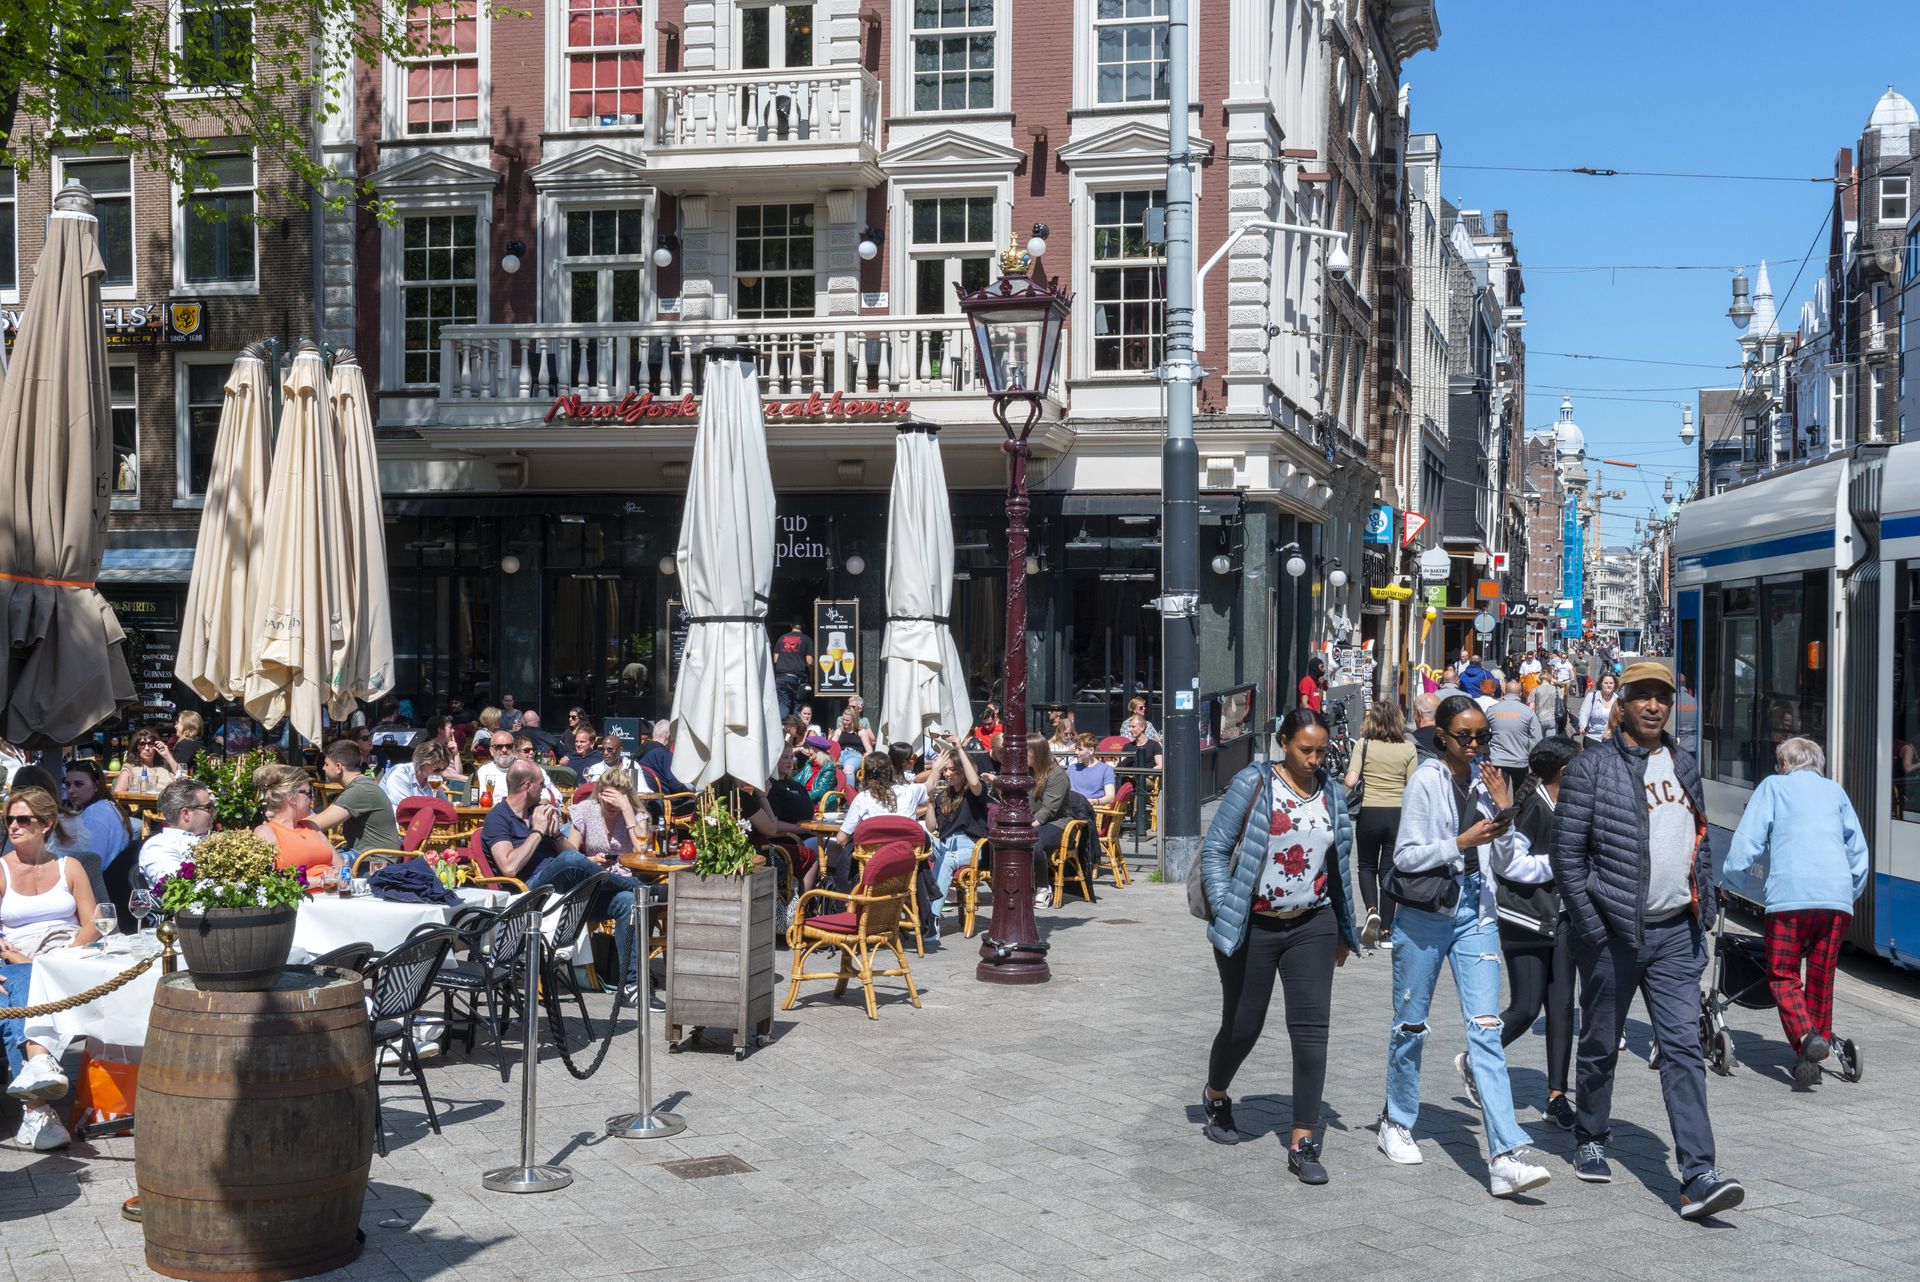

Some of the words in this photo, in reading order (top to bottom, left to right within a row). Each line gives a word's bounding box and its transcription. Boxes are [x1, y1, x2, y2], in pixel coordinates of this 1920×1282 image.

[617, 392, 699, 425] York
[762, 391, 911, 416] eakhouse
[1368, 512, 1380, 522] to
[776, 515, 808, 531] ub
[1371, 520, 1385, 532] go
[122, 602, 156, 612] SPIRITS
[1510, 604, 1526, 615] JD
[144, 669, 173, 678] GUINNESS
[144, 682, 172, 690] KILKENNY
[143, 712, 173, 720] BULMERS
